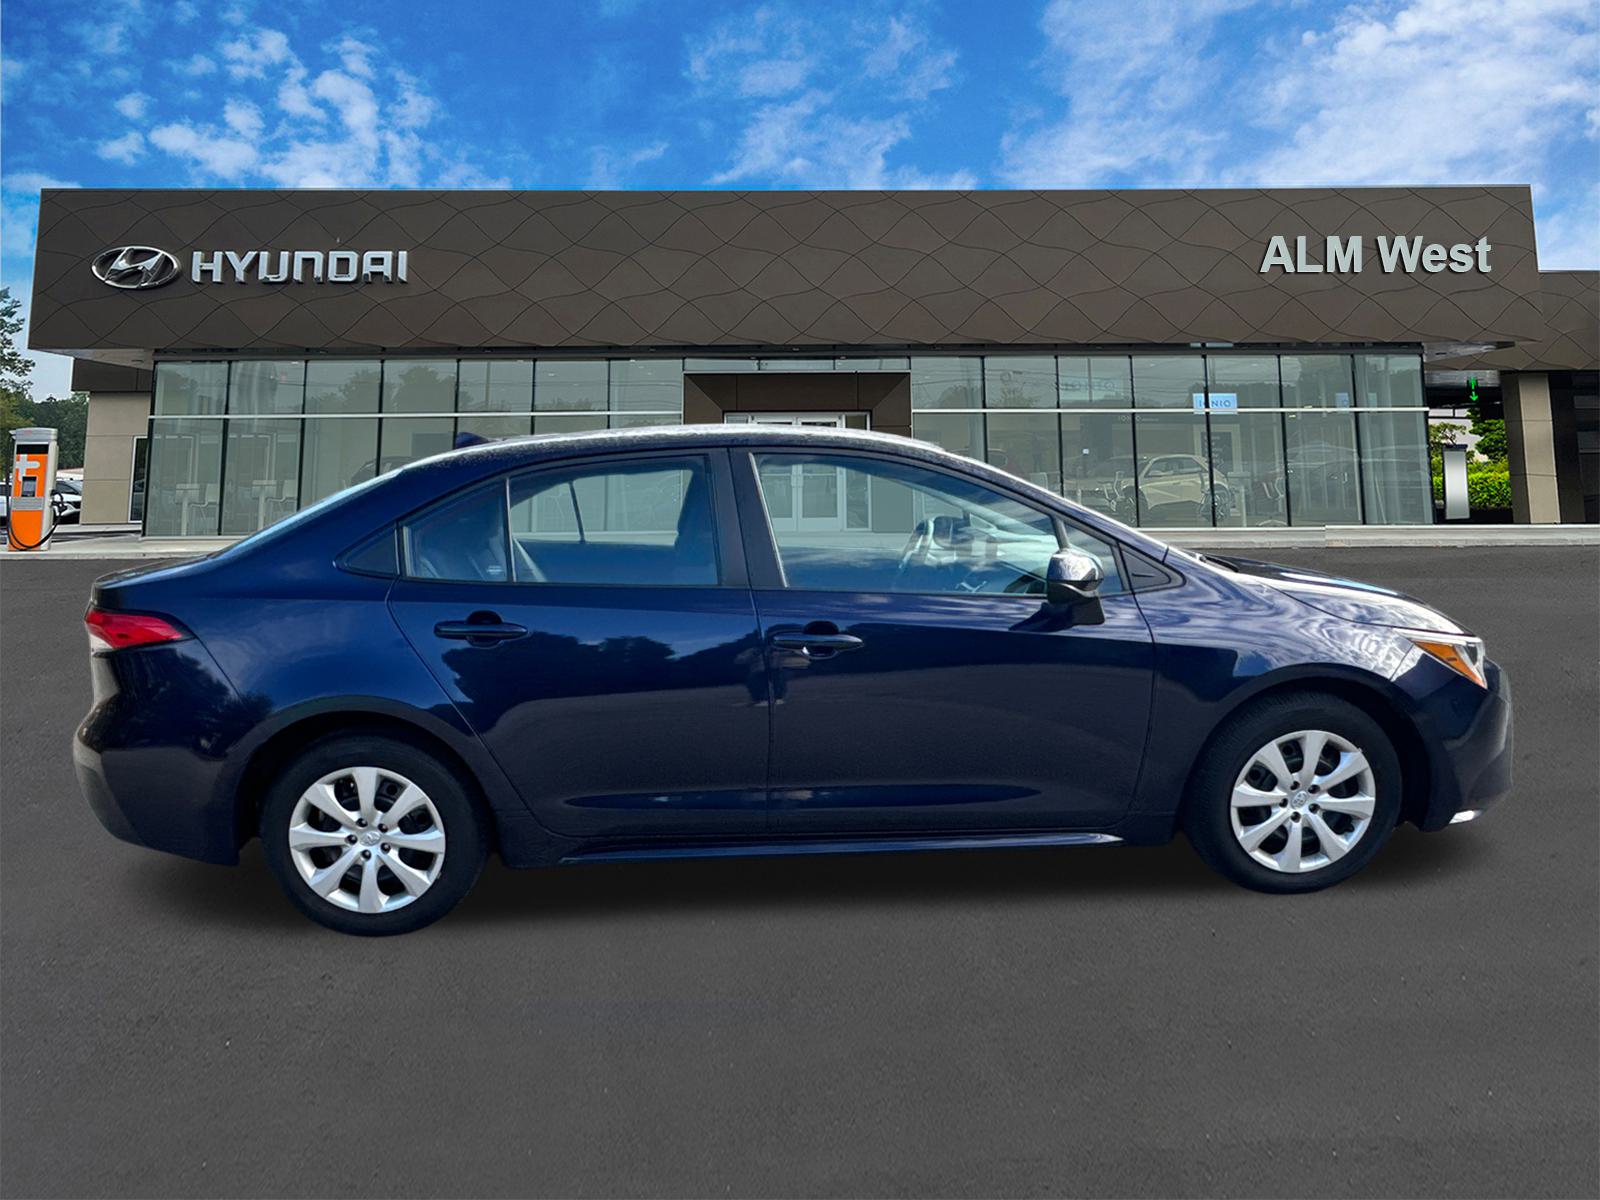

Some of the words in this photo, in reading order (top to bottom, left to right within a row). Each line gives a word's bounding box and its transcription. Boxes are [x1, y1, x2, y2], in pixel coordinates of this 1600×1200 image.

[191, 251, 408, 283] HYUNDAI
[1260, 235, 1363, 273] ALM
[1376, 235, 1492, 273] West
